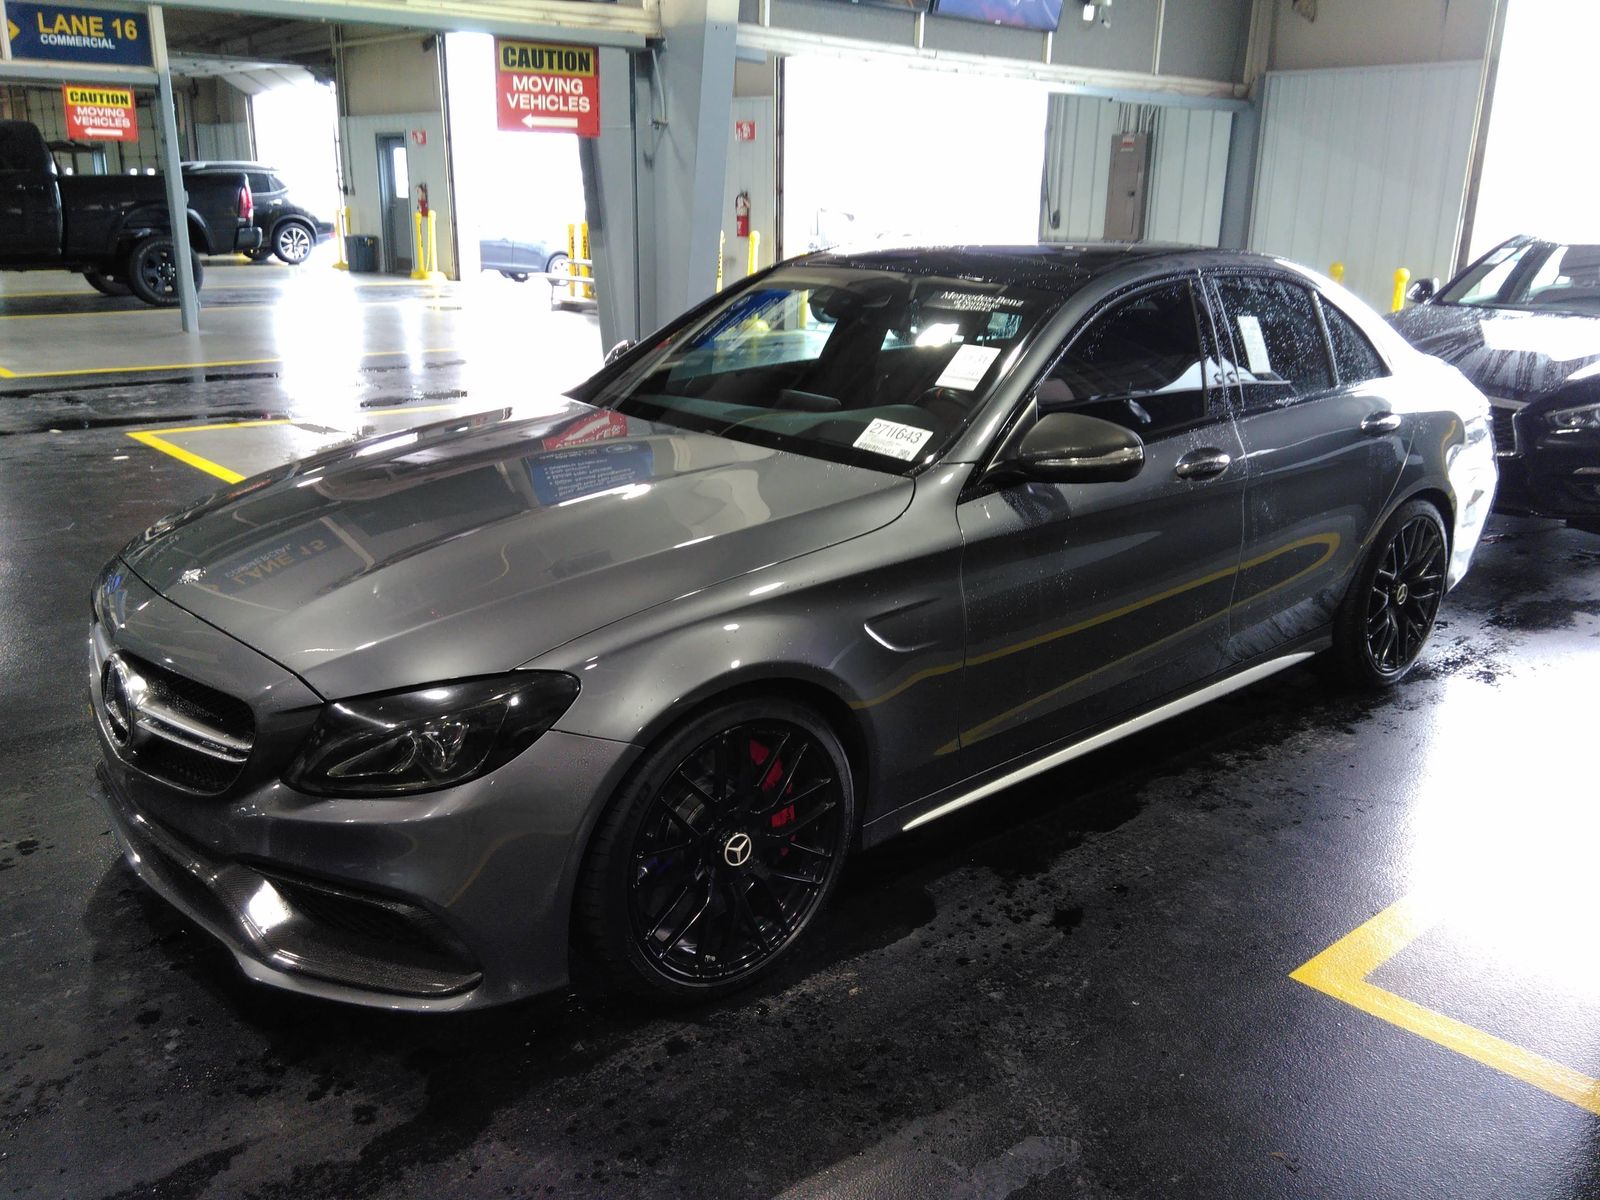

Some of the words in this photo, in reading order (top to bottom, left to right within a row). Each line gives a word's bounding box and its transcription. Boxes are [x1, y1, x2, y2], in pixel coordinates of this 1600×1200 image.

[37, 12, 105, 38] LANE
[112, 18, 138, 40] 16
[40, 34, 116, 50] COMMERCIAL
[503, 46, 590, 73] CAUTION
[512, 75, 583, 94] MOVING
[69, 91, 130, 105] CAUTION
[506, 93, 590, 113] VEHICLES
[76, 106, 126, 118] MOVING
[73, 115, 131, 128] VEHICLES
[940, 291, 1024, 308] Mercedes-Benz
